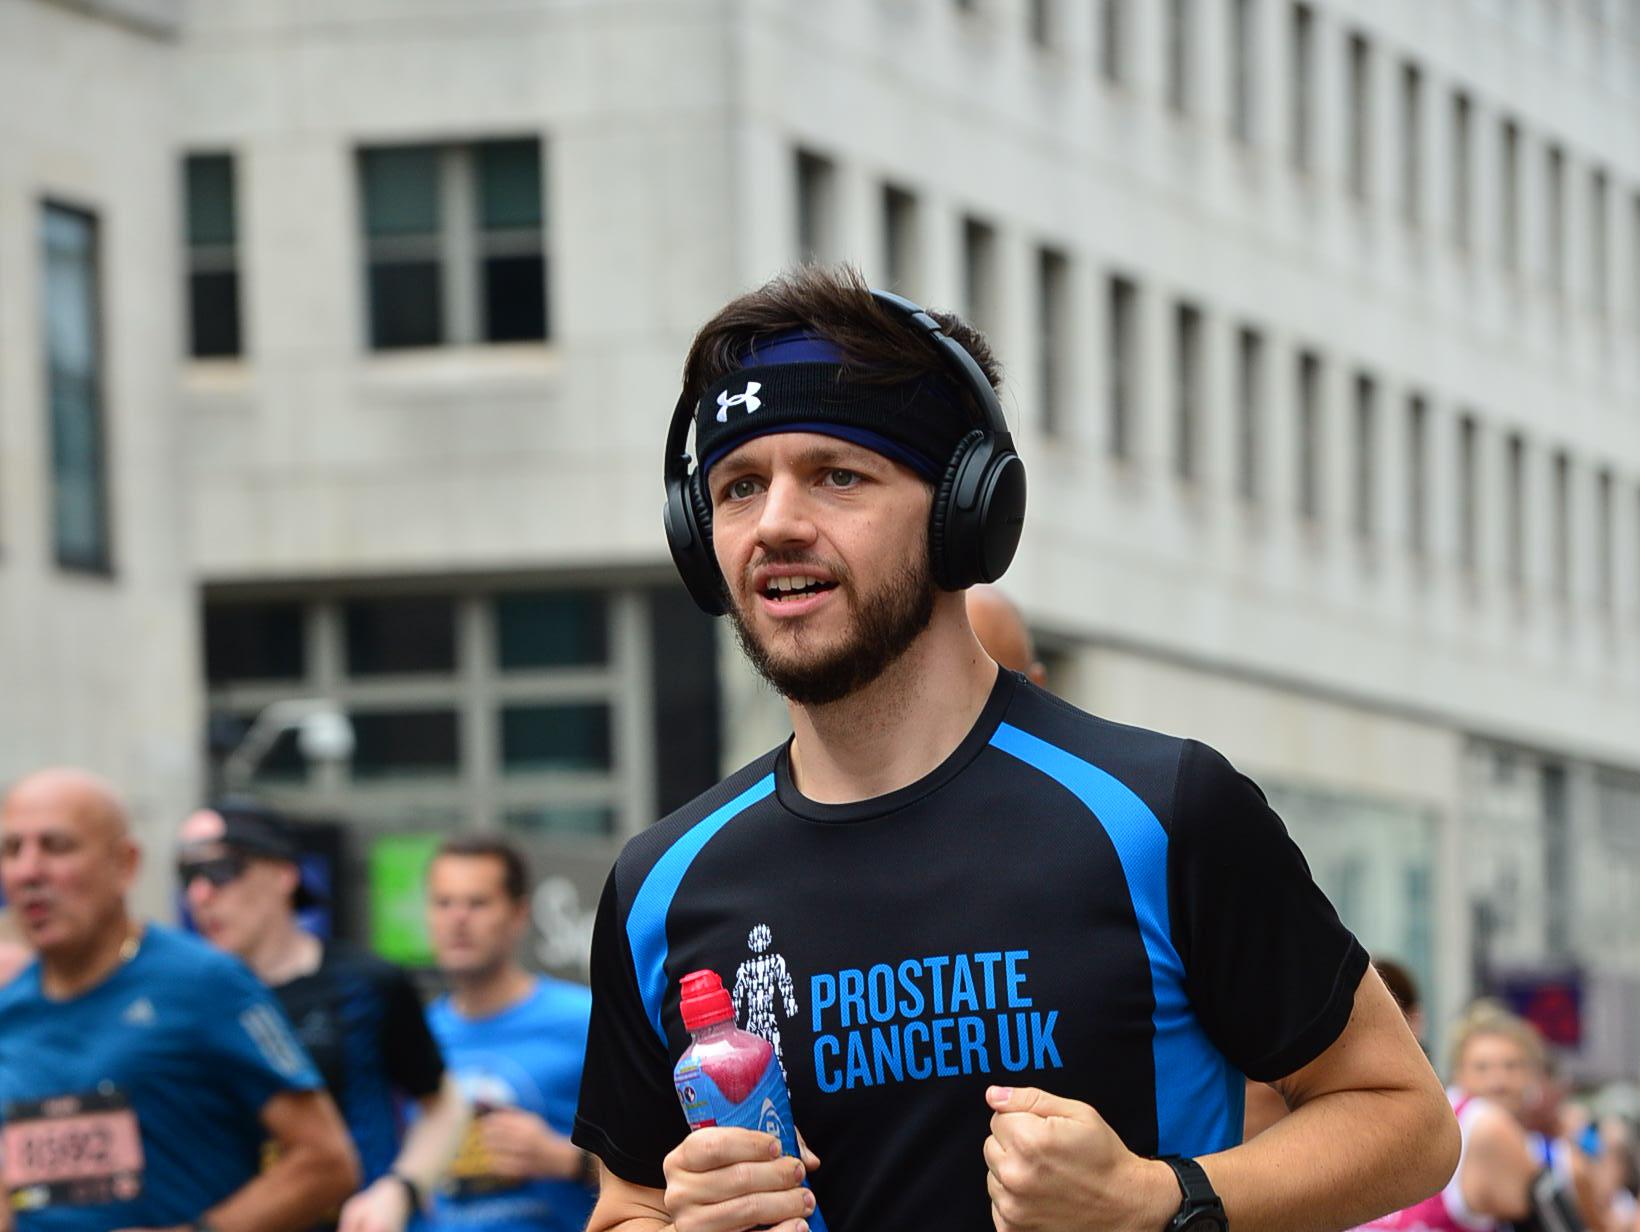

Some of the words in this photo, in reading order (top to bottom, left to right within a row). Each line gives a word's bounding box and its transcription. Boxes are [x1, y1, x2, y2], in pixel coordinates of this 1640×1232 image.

[811, 950, 1033, 1033] PROSTATE
[813, 1016, 991, 1094] CANCER
[997, 1010, 1064, 1072] UK
